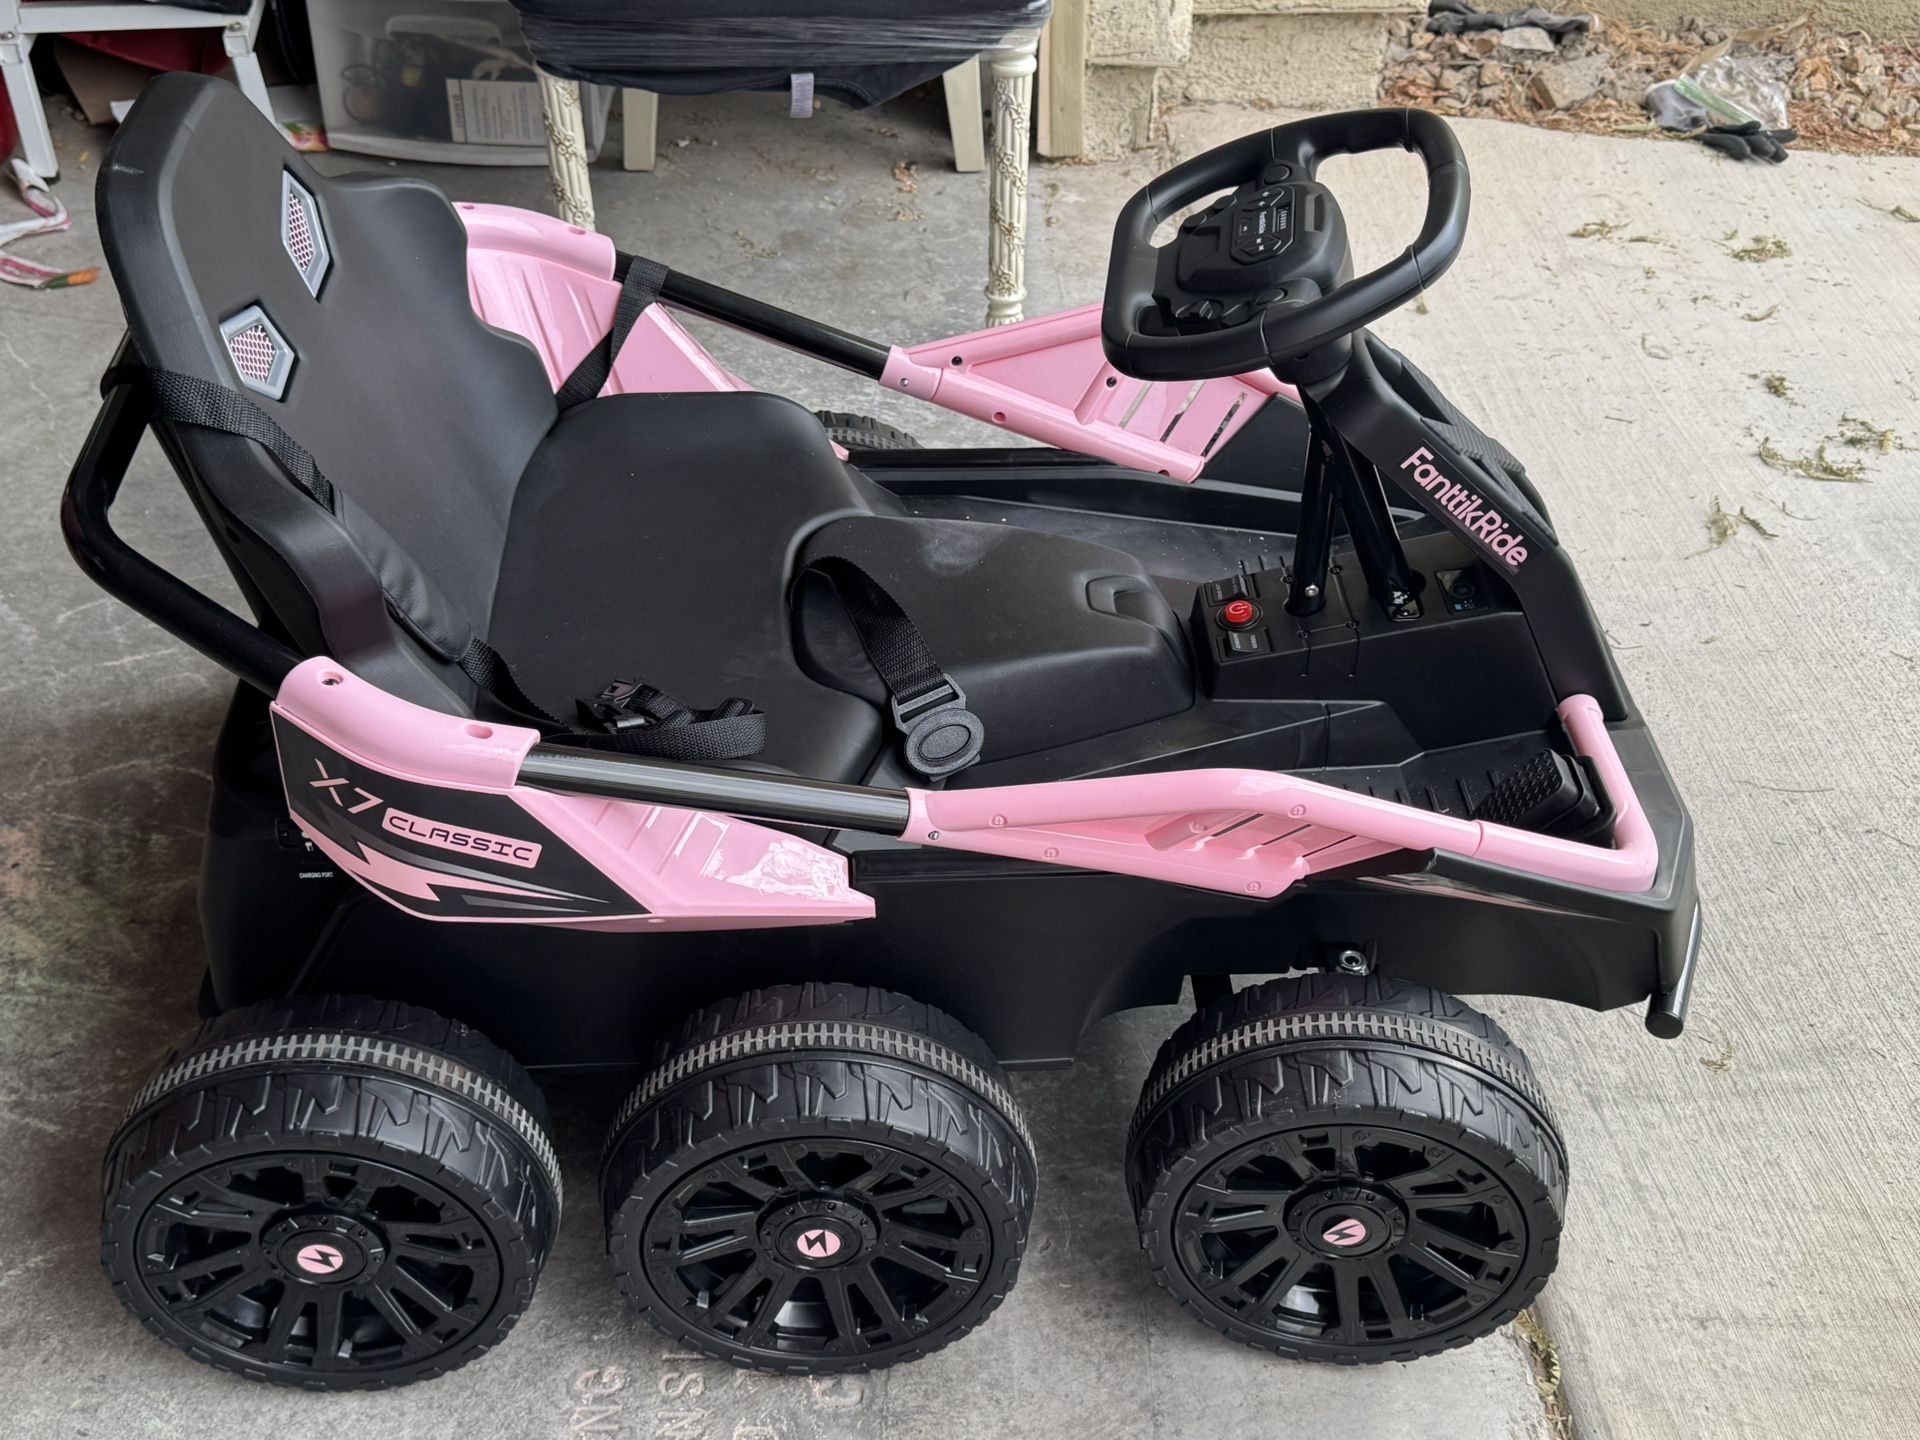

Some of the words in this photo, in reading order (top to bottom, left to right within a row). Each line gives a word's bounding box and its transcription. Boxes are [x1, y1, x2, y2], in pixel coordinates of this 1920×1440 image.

[1400, 446, 1528, 566] FanttikRide
[309, 758, 384, 815] X7
[388, 815, 533, 861] CLASSIC
